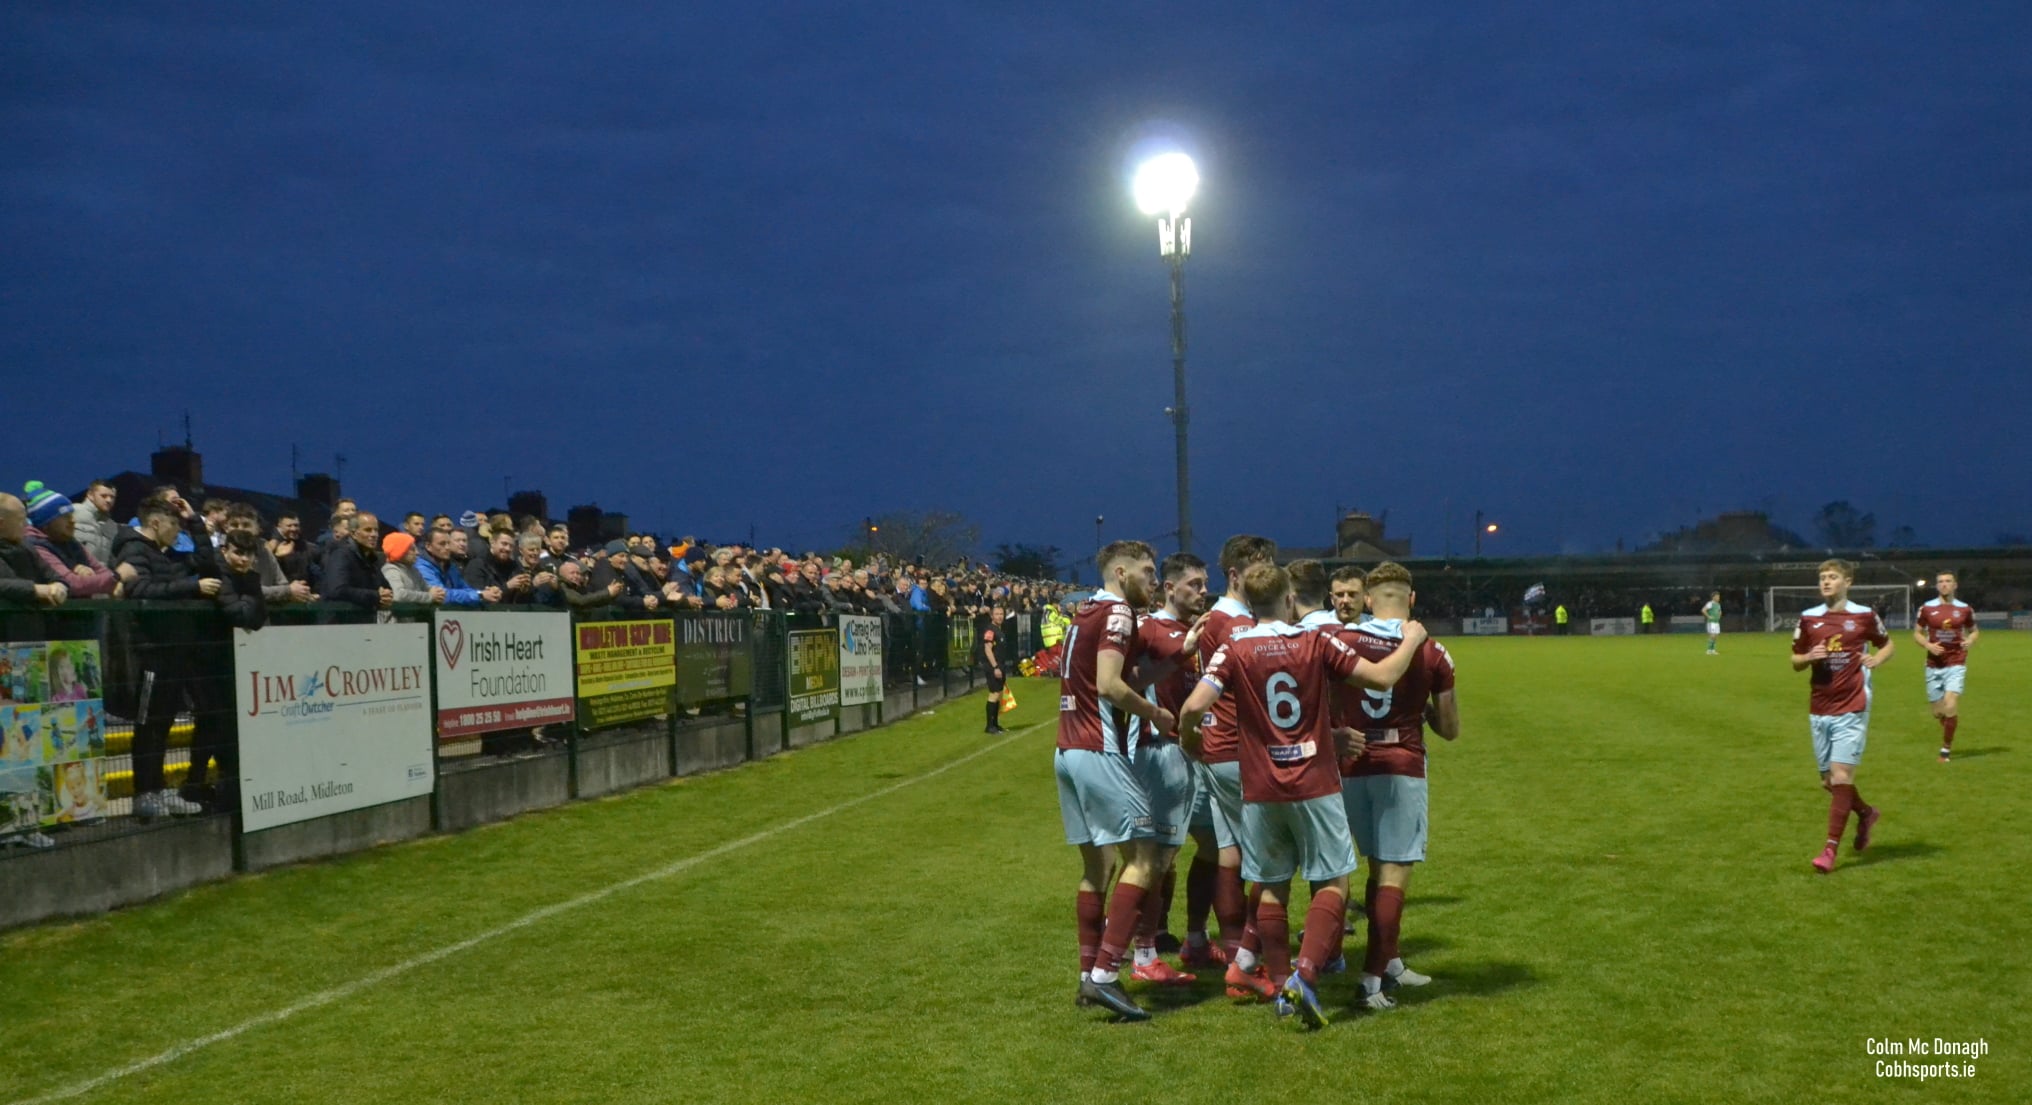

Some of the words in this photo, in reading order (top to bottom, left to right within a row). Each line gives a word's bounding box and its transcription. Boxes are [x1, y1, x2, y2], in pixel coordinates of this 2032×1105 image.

[469, 631, 501, 663] Irish
[505, 632, 544, 661] Heart
[683, 618, 744, 645] DISTRICT
[1254, 643, 1279, 655] JOYCE
[247, 671, 297, 717] JIM
[325, 665, 423, 698] CROWLEY
[471, 665, 546, 698] Foundation
[1265, 671, 1302, 729] 6
[251, 790, 275, 813] Mill
[278, 784, 309, 808] Road,
[311, 779, 354, 802] Midleton
